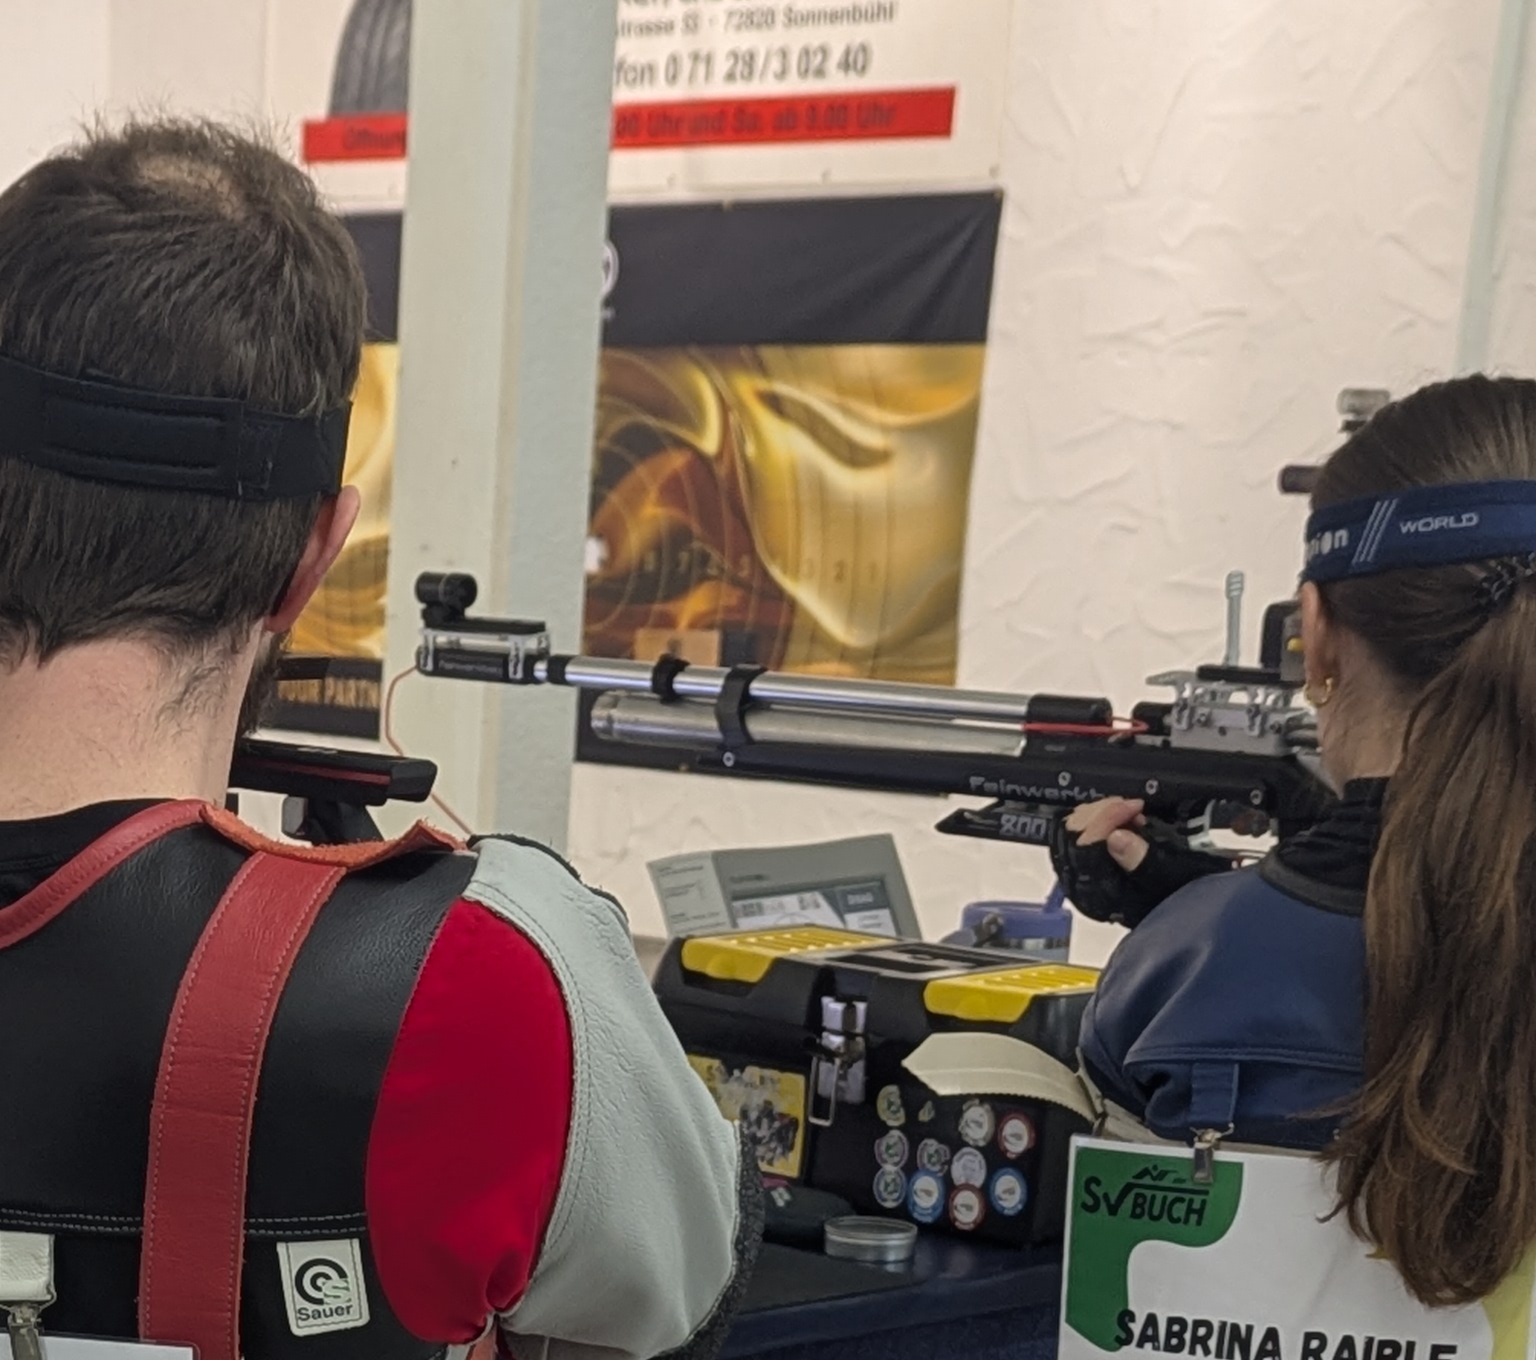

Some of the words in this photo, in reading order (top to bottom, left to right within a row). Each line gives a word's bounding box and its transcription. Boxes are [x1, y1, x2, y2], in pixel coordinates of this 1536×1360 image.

[665, 53, 680, 85] 0
[687, 49, 712, 83] 71
[796, 42, 827, 79] 02
[836, 39, 870, 77] 40
[1400, 512, 1479, 535] WORLD
[1000, 813, 1047, 841] 800
[1130, 1196, 1207, 1227] BUCH
[297, 1304, 353, 1321] Sauer
